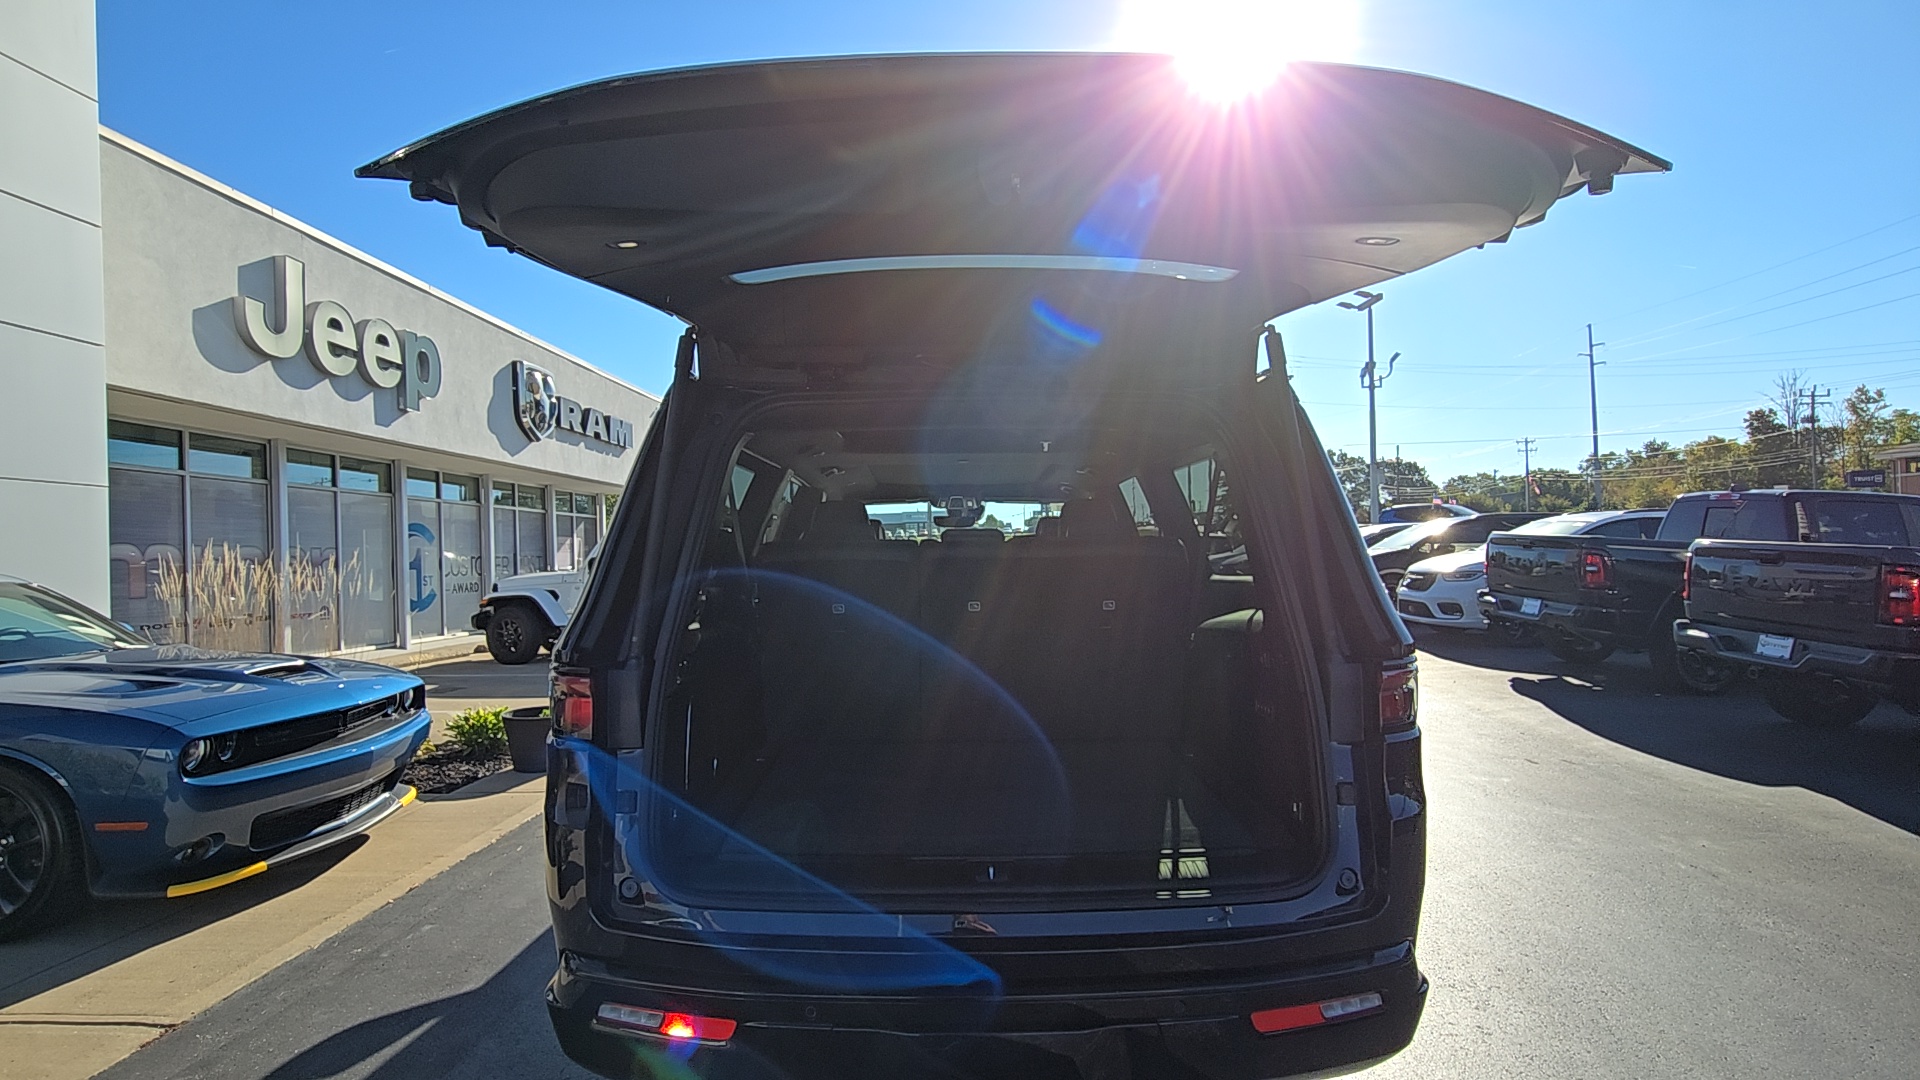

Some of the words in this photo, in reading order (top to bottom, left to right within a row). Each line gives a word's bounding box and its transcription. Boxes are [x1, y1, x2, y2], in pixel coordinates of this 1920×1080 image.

[233, 255, 441, 412] Jeep
[556, 396, 633, 448] RAM
[443, 555, 510, 577] CUSTOER
[1505, 556, 1547, 571] RAM
[451, 581, 479, 594] AWARD
[1723, 564, 1815, 595] RAM
